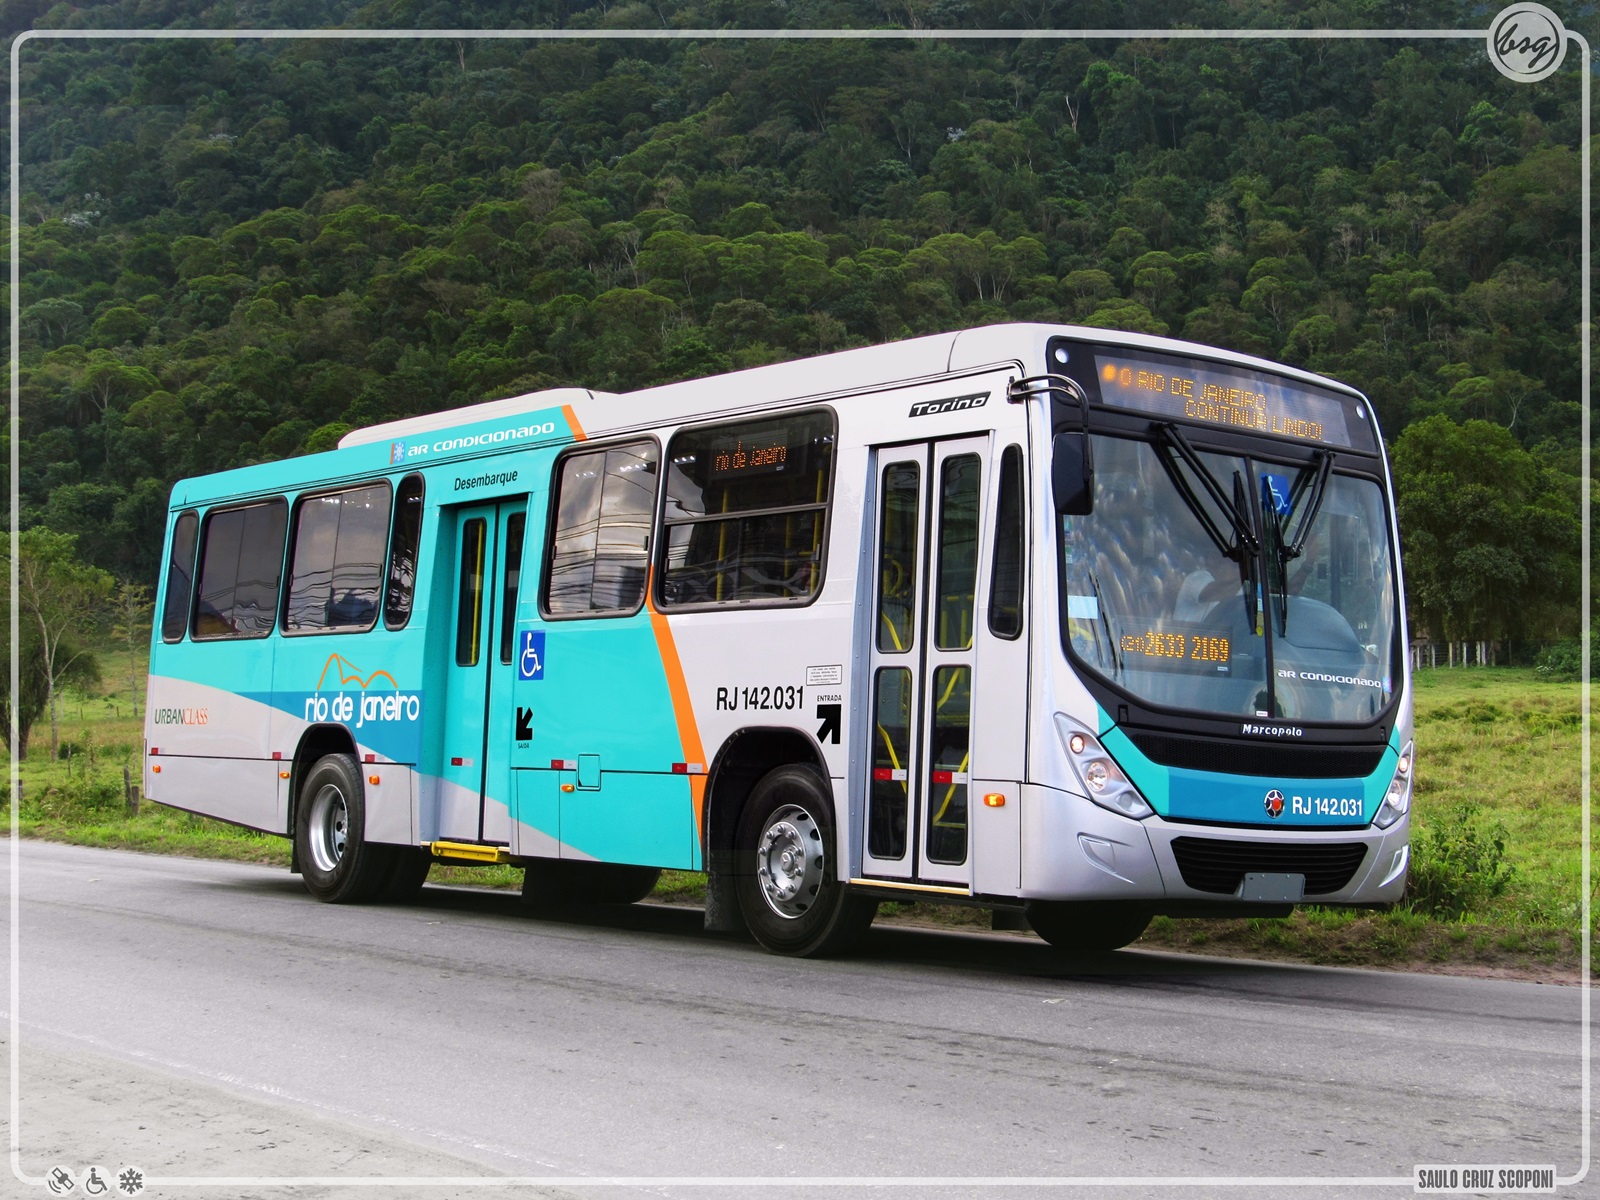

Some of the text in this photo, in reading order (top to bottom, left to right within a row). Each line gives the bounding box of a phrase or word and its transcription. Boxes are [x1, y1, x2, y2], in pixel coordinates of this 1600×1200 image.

[1138, 370, 1165, 392] RIO
[1171, 377, 1194, 397] DE
[1199, 383, 1266, 411] JANEIRO
[913, 397, 986, 415] Torino
[1185, 399, 1322, 440] CONTINUA LINDO!
[715, 450, 730, 471] rio
[732, 440, 746, 468] de
[454, 470, 518, 491] Desembarque
[1191, 635, 1229, 662] 2169
[304, 690, 420, 728] rio de janeiro
[716, 685, 804, 711] RJ 142.031
[816, 694, 842, 702] ENTRADA
[1242, 723, 1303, 737] Marcopolo
[1292, 796, 1363, 817] RJ 142.031
